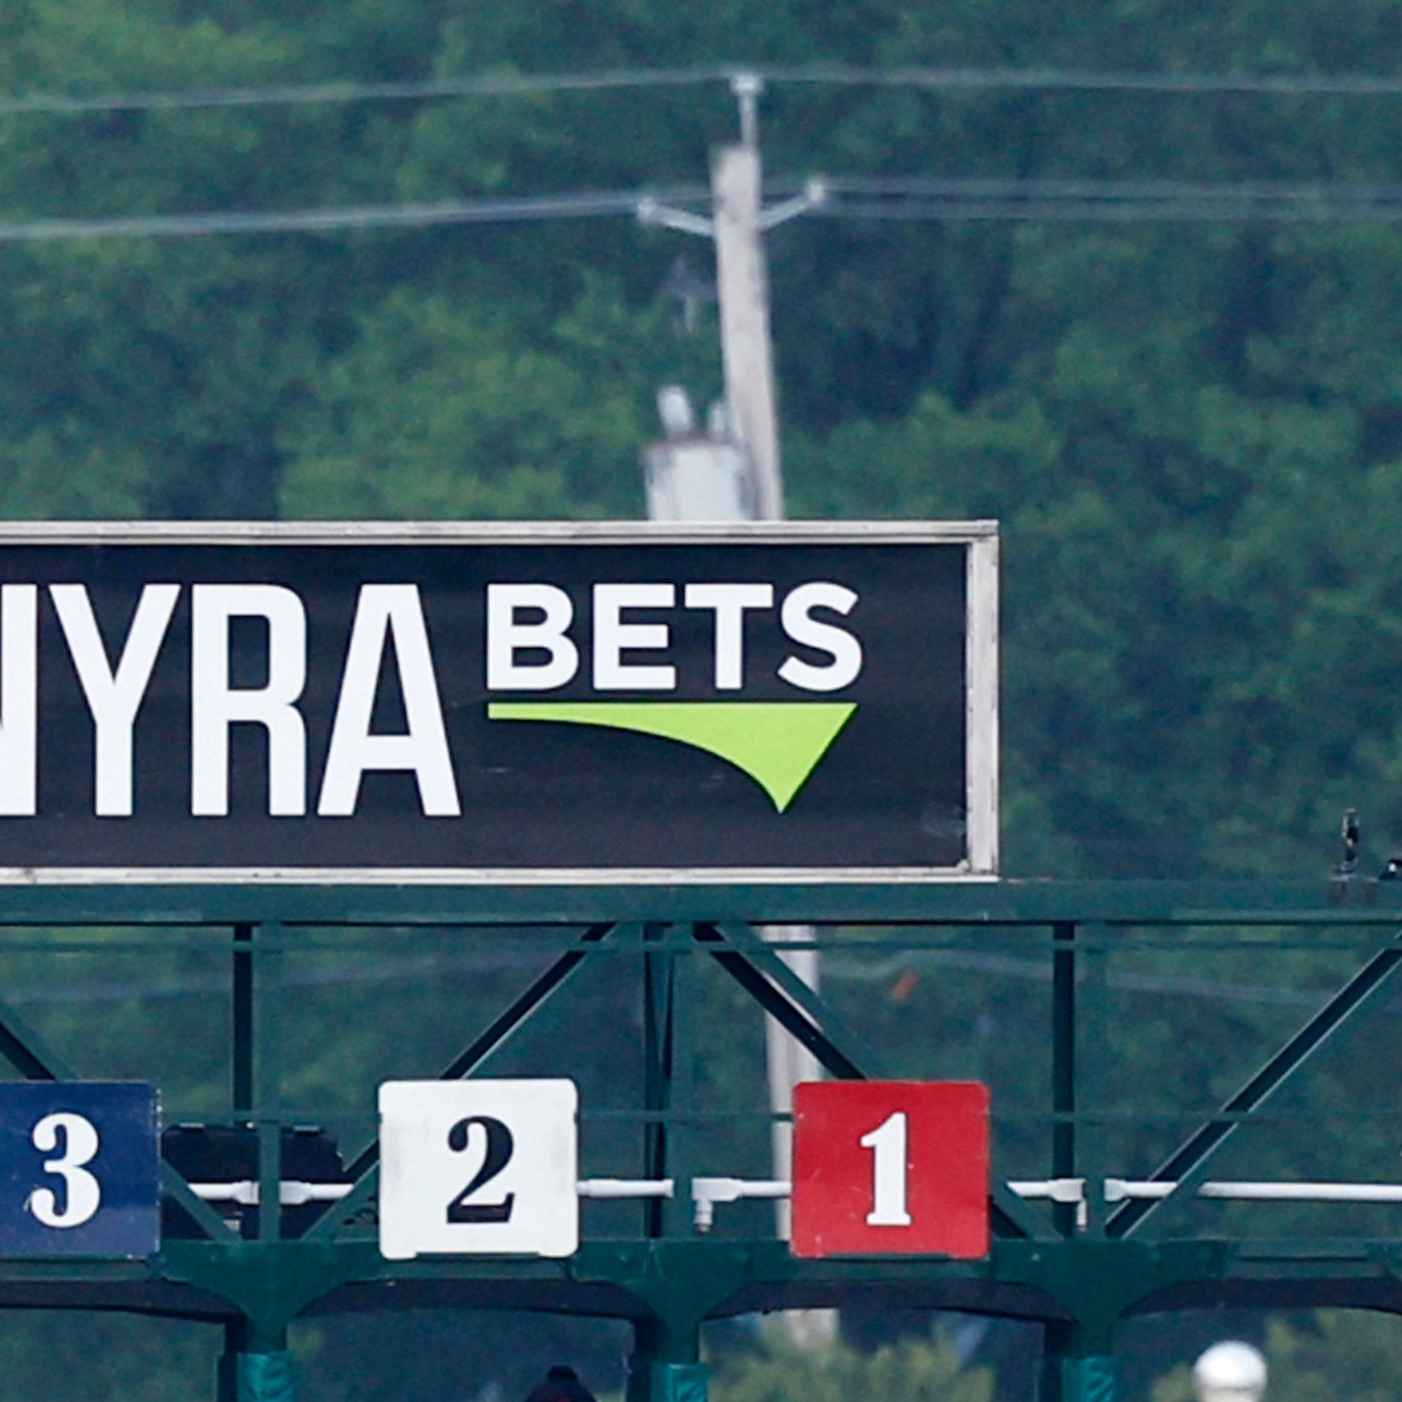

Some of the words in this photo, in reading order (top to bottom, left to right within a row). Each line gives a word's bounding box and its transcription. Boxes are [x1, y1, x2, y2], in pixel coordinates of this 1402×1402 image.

[487, 582, 862, 692] BETS
[30, 1112, 100, 1228] 3
[446, 1116, 515, 1224] 2
[860, 1112, 911, 1227] 1
